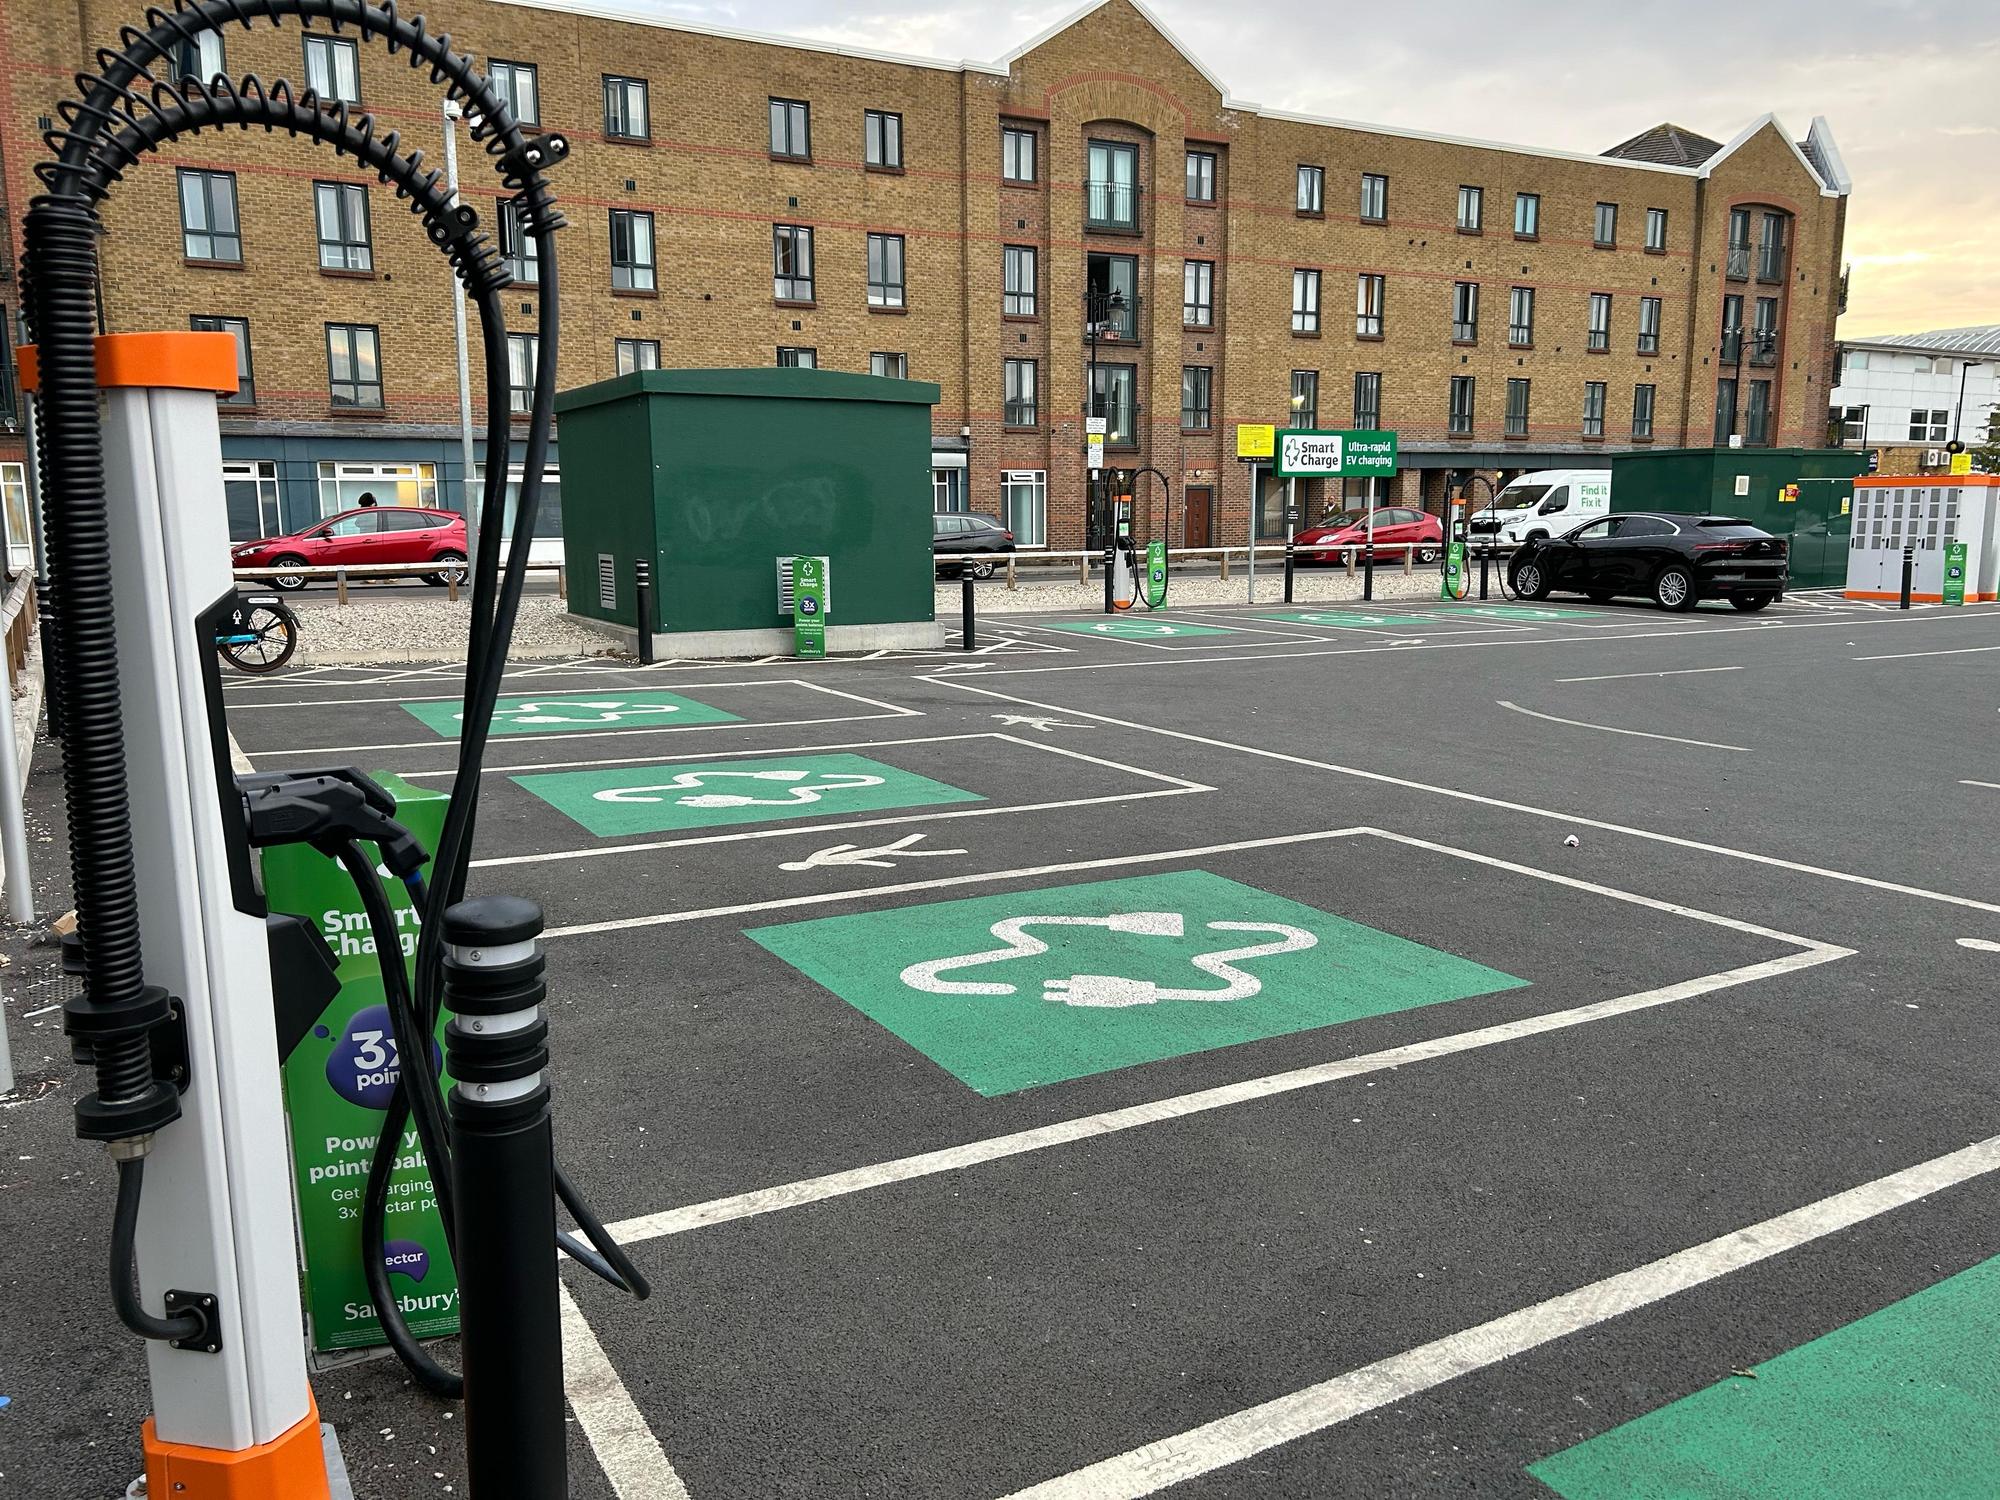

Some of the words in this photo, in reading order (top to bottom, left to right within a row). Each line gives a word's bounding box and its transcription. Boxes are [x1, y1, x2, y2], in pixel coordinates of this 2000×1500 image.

[1301, 442, 1334, 453] Smart
[1348, 442, 1391, 455] Ultra-rapid
[1300, 454, 1339, 469] Charge
[1346, 456, 1358, 466] EV
[1358, 455, 1393, 468] charging
[1581, 485, 1600, 495] Find
[1601, 485, 1607, 495] it
[1581, 497, 1594, 507] Fix
[1594, 497, 1602, 507] it
[803, 600, 815, 608] 3x
[323, 904, 422, 933] Smrt
[356, 1068, 400, 1091] poin
[325, 1135, 380, 1153] Pow
[309, 1159, 373, 1184] point
[331, 1187, 360, 1201] Get
[387, 1180, 433, 1196] arging
[338, 1206, 358, 1219] 3x
[385, 1200, 416, 1214] ctar
[385, 1252, 423, 1266] ectar
